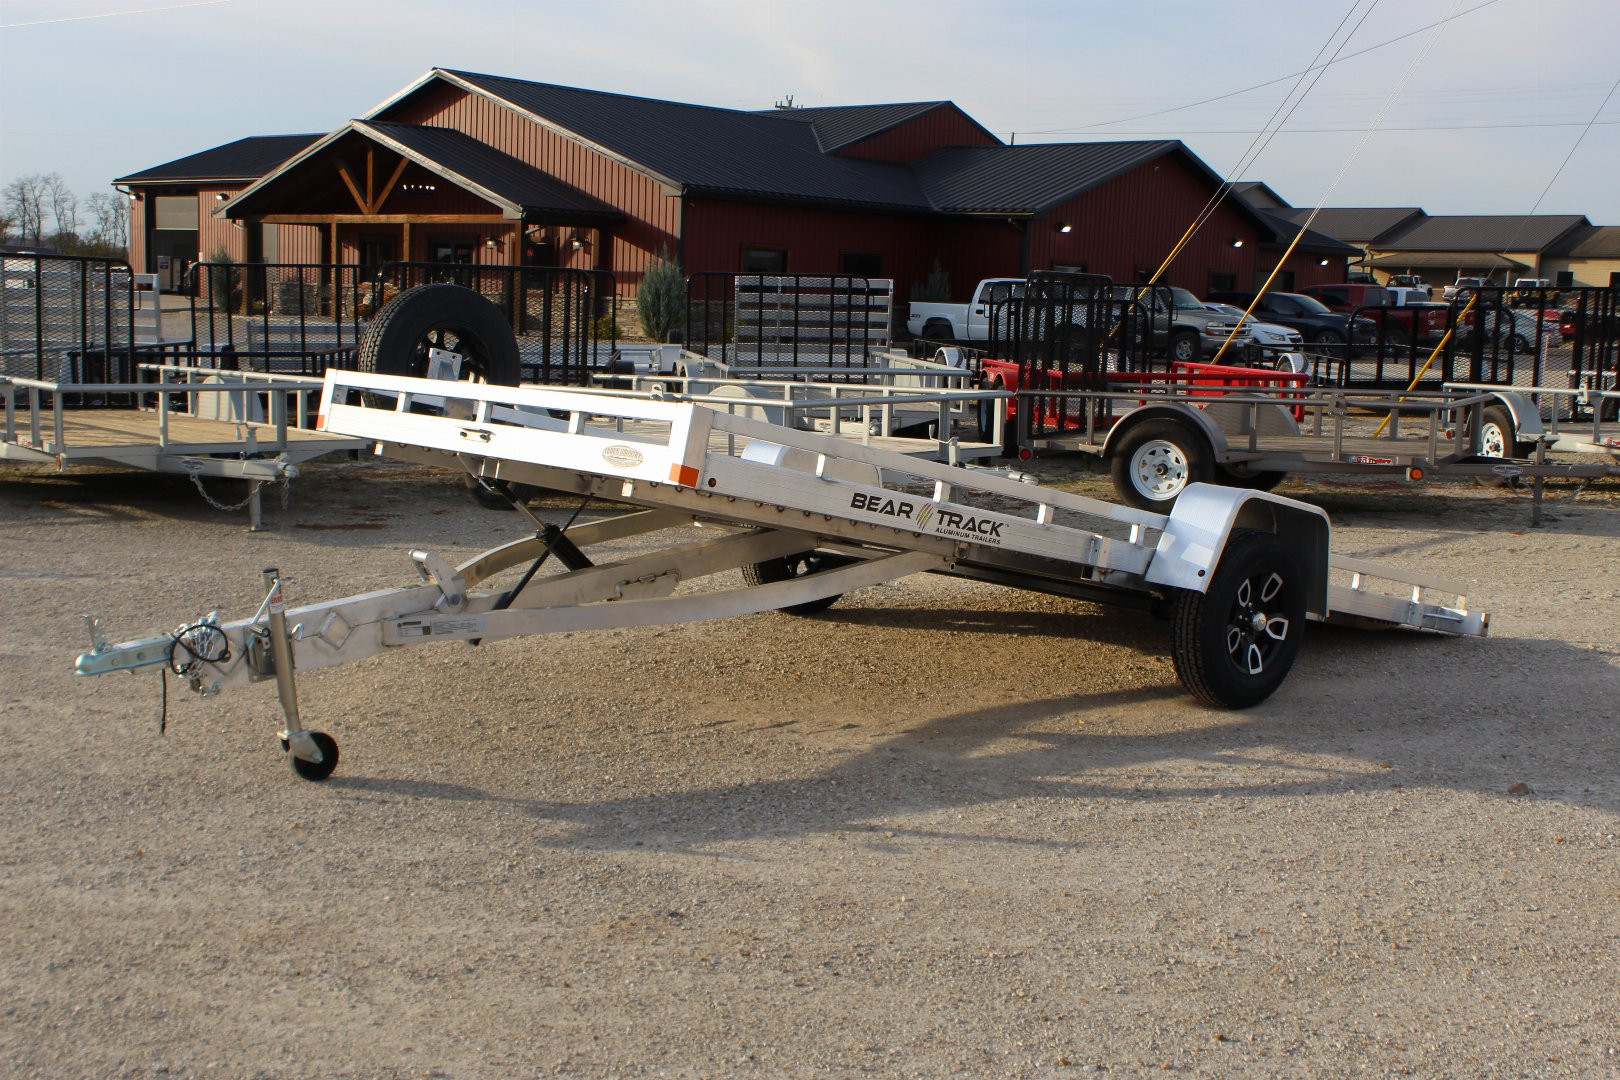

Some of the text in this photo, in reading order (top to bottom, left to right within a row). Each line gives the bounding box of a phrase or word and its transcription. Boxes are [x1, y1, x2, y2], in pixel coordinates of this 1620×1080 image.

[850, 492, 1004, 537] BEAR TRACK
[935, 527, 1001, 545] ALUMINUM TRAILERS
